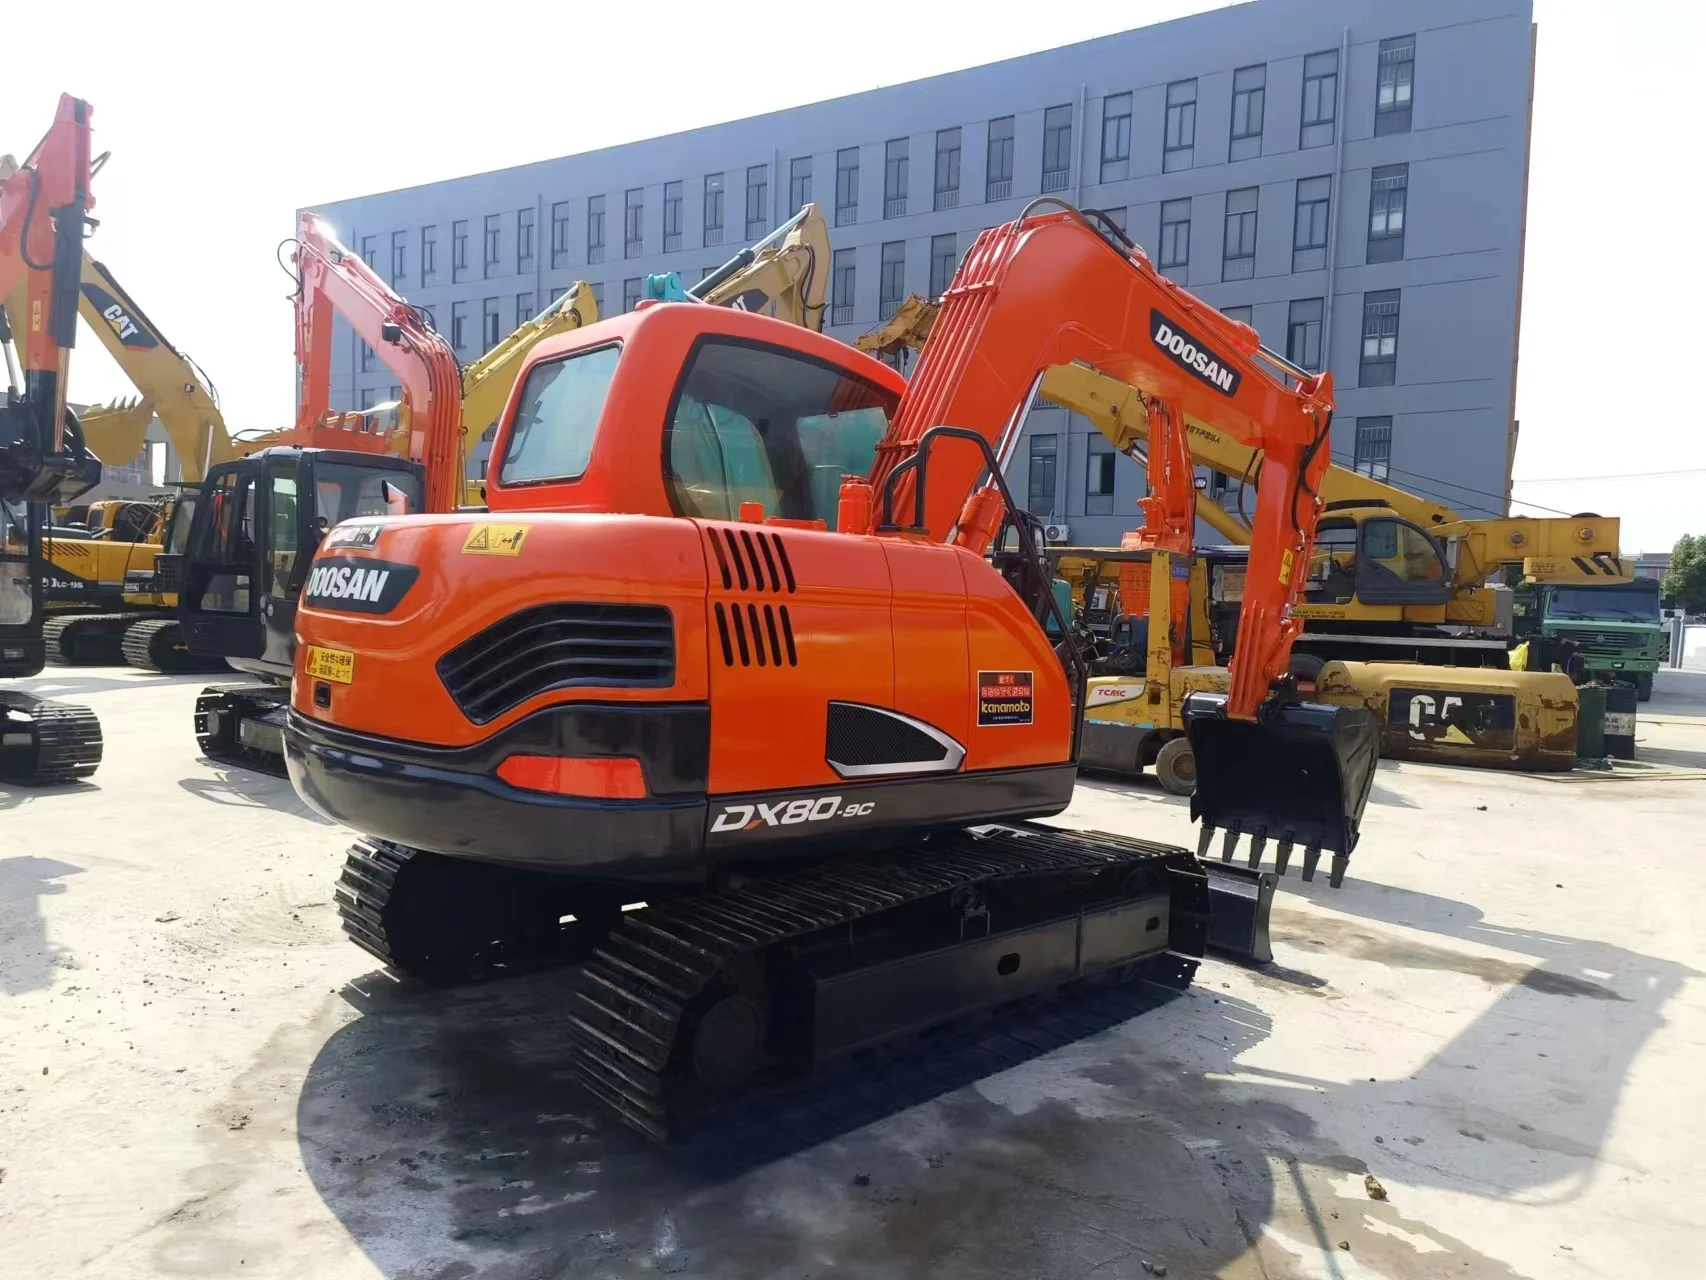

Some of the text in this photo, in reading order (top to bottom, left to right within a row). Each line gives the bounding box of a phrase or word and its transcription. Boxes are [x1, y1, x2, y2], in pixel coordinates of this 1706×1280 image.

[103, 304, 139, 340] CAT
[1154, 323, 1234, 391] DOOSAN
[306, 566, 390, 602] DOOSAN
[981, 700, 1031, 714] kanamoto
[709, 796, 876, 833] DX80-9C
